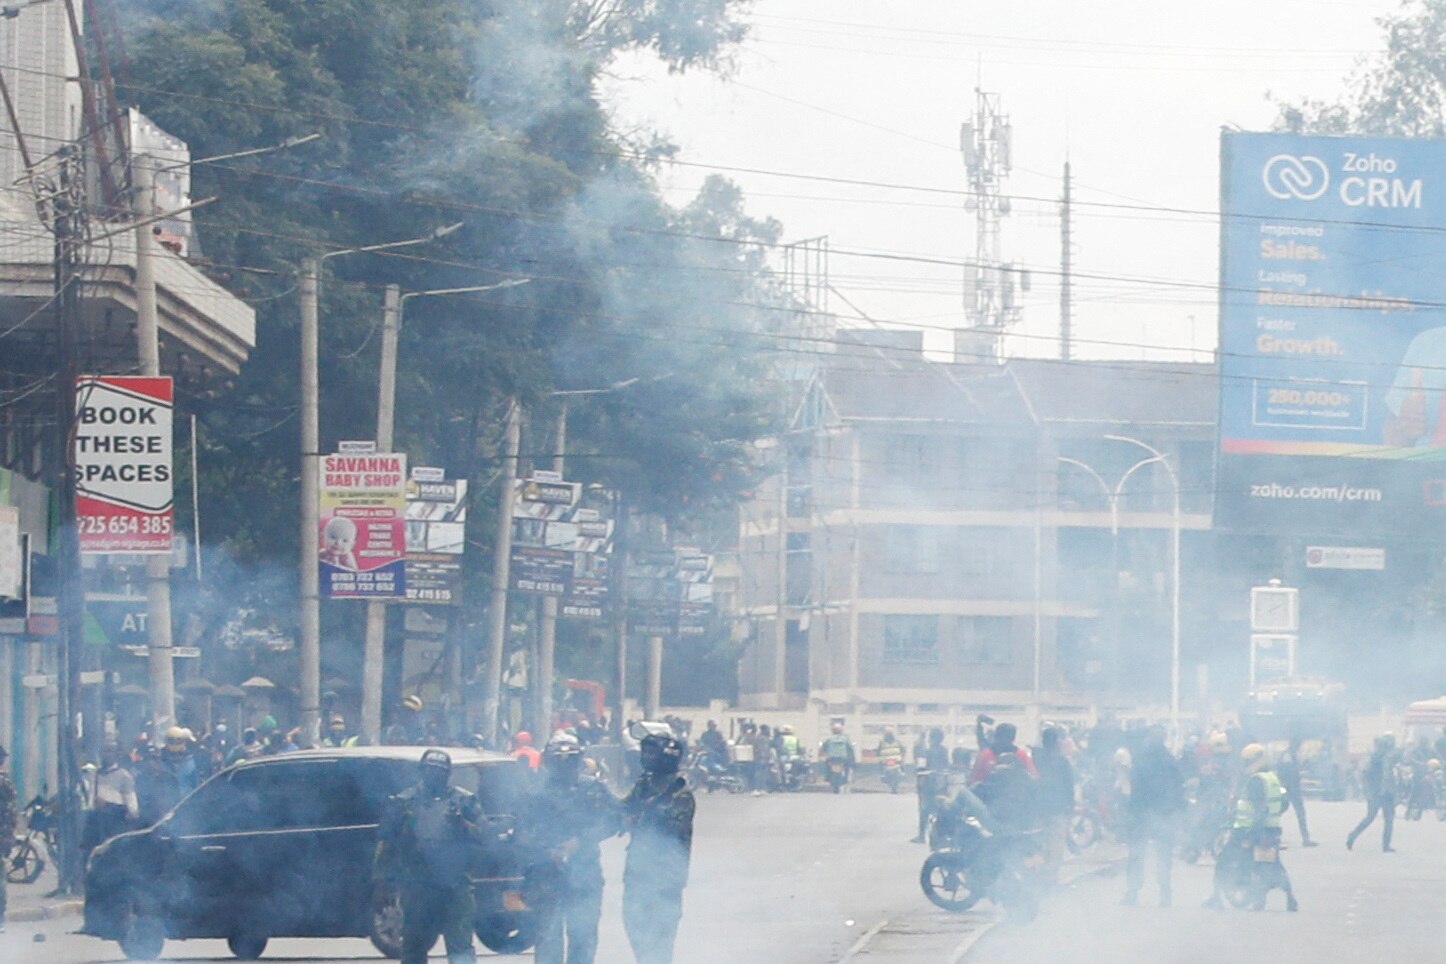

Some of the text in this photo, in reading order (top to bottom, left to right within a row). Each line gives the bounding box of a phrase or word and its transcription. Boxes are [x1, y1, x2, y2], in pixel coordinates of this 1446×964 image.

[1342, 152, 1397, 174] Zoho
[1339, 176, 1423, 209] CRM
[1256, 333, 1345, 356] Growth.
[81, 406, 157, 425] BOOK
[76, 436, 162, 453] THESE
[76, 464, 169, 482] SPACES
[325, 457, 400, 473] SAVANNA
[325, 474, 401, 487] BABY SHOP
[1251, 482, 1382, 503] zoho.com/crm
[108, 516, 139, 534] 654
[141, 516, 171, 534] 385
